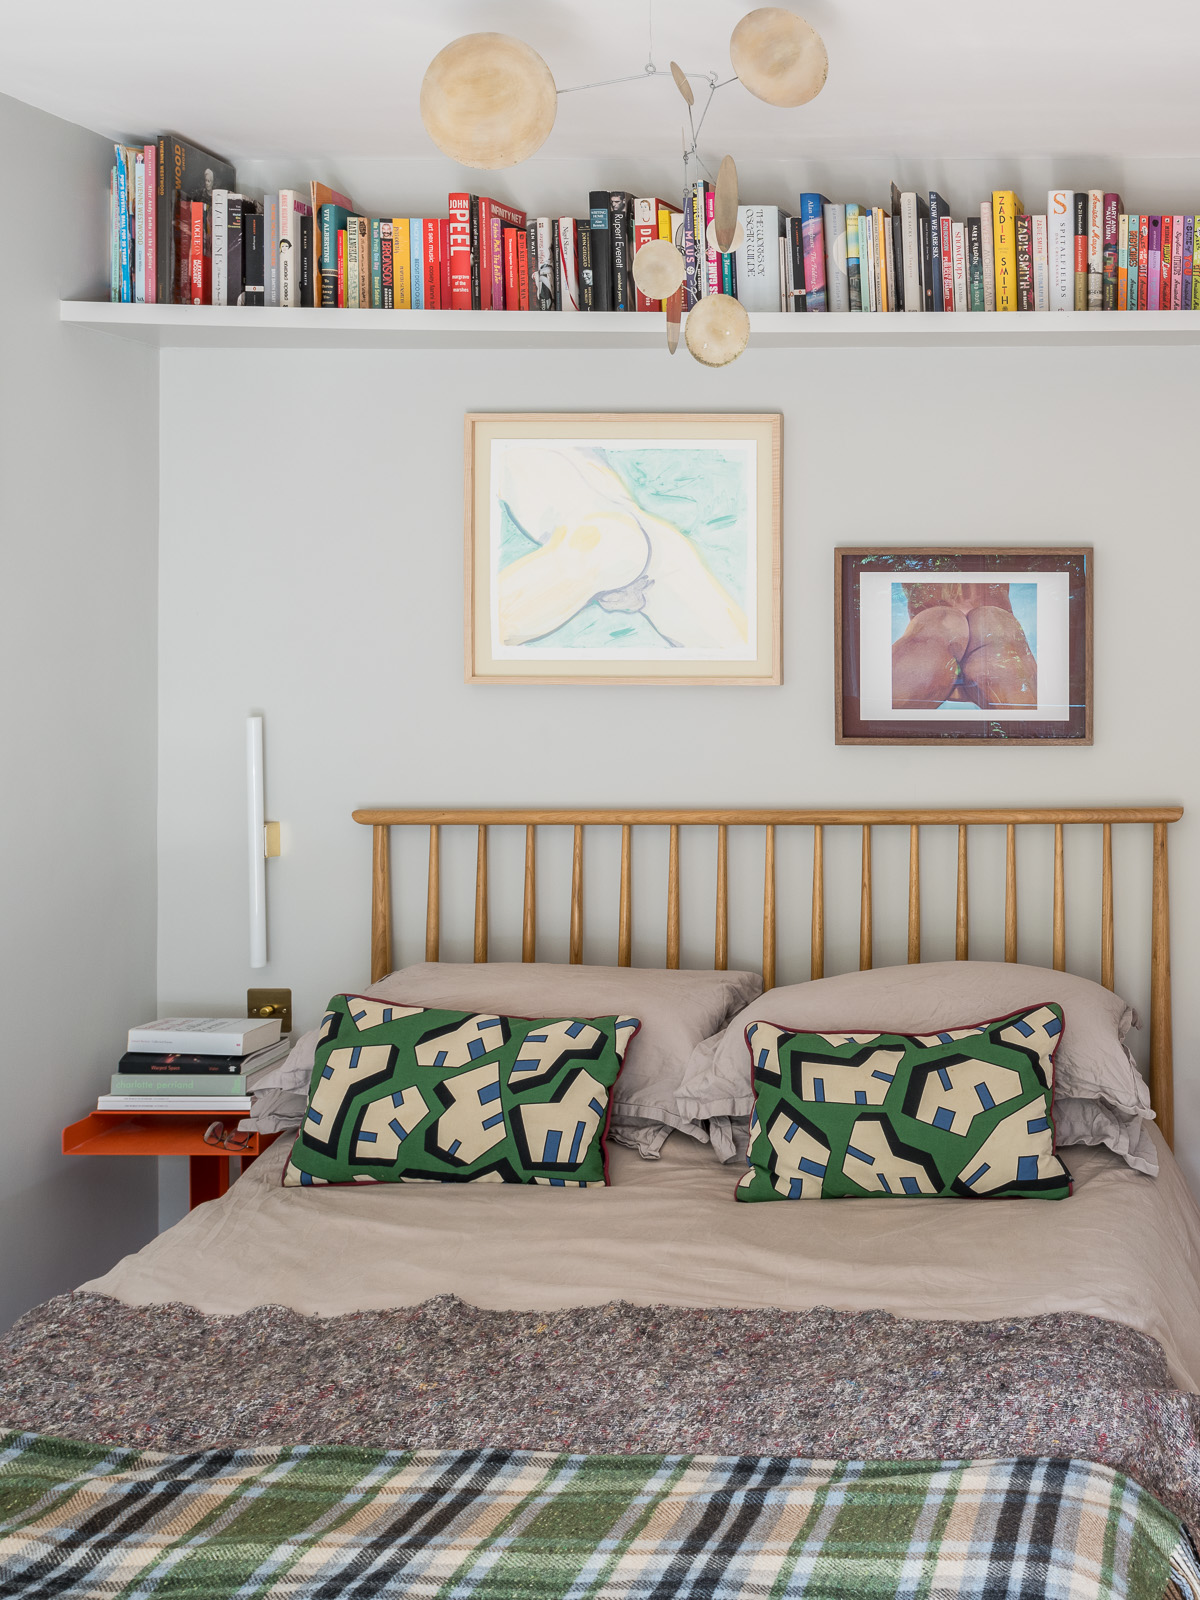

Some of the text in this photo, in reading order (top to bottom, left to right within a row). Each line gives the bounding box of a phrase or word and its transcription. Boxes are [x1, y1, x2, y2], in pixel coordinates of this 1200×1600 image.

[450, 200, 468, 208] JOHN
[508, 212, 522, 224] NET
[449, 209, 470, 256] PEEL
[613, 214, 624, 268] Rupert Everett
[932, 219, 937, 230] WE
[1091, 194, 1101, 256] Armistead Maupin
[348, 238, 357, 263] ANGELOU
[685, 230, 694, 263] MAUS
[746, 209, 755, 277] OSCAR WILDE
[757, 230, 765, 263] WORKS
[955, 232, 964, 279] snowdrops
[1017, 220, 1030, 289] ZADIE SMITH
[1129, 231, 1138, 267] BABYCAKES
[382, 241, 392, 286] BRONSON
[708, 262, 718, 284] GAME
[758, 264, 765, 276] OF
[1184, 255, 1192, 275] YOU
[1000, 258, 1008, 304] SMITH
[116, 1079, 194, 1090] charlotte perriand
